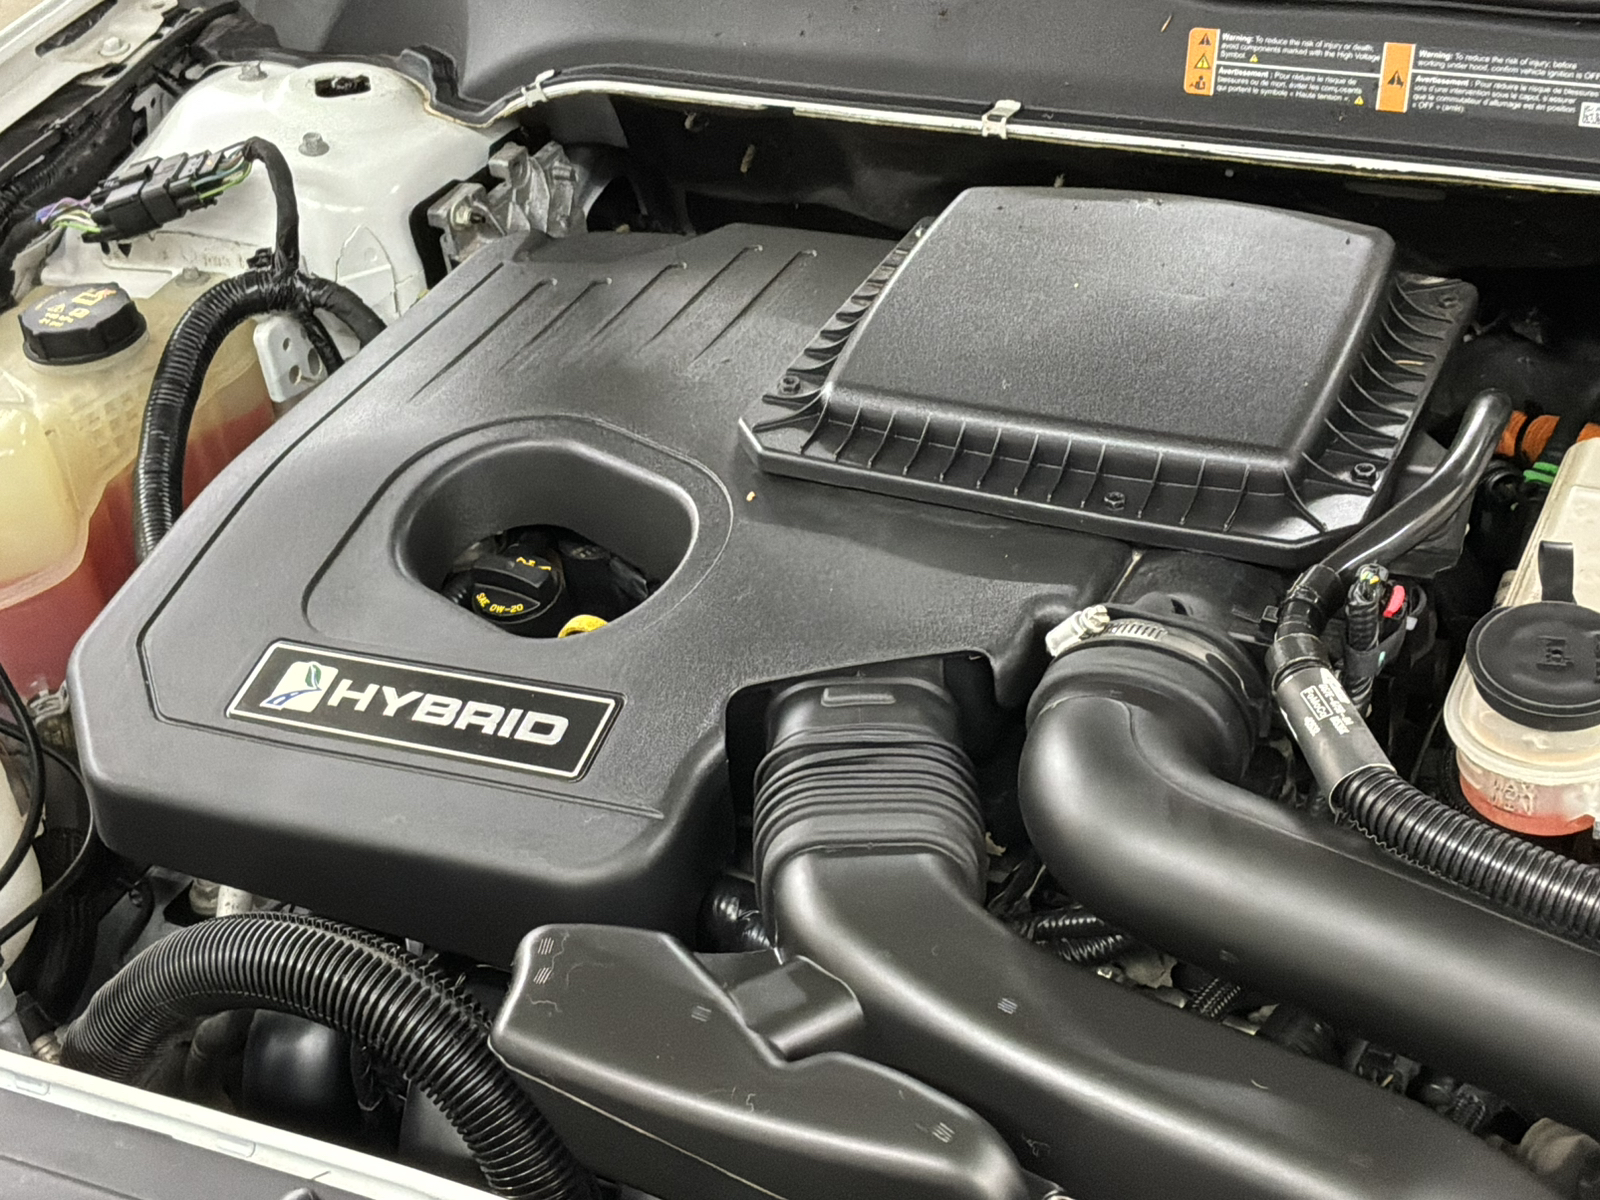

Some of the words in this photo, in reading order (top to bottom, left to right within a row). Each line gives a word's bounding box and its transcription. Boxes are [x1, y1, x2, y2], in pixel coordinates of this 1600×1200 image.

[1222, 33, 1254, 43] Warning:
[1289, 38, 1300, 46] the
[1301, 39, 1313, 47] risk
[1315, 40, 1323, 48] of
[1455, 52, 1463, 61] To
[1492, 55, 1503, 64] the
[1520, 58, 1528, 66] of
[476, 592, 490, 608] SAE
[489, 603, 524, 613] 0W-20
[328, 678, 569, 745] HYBRID
[1303, 689, 1328, 718] FoMoCo
